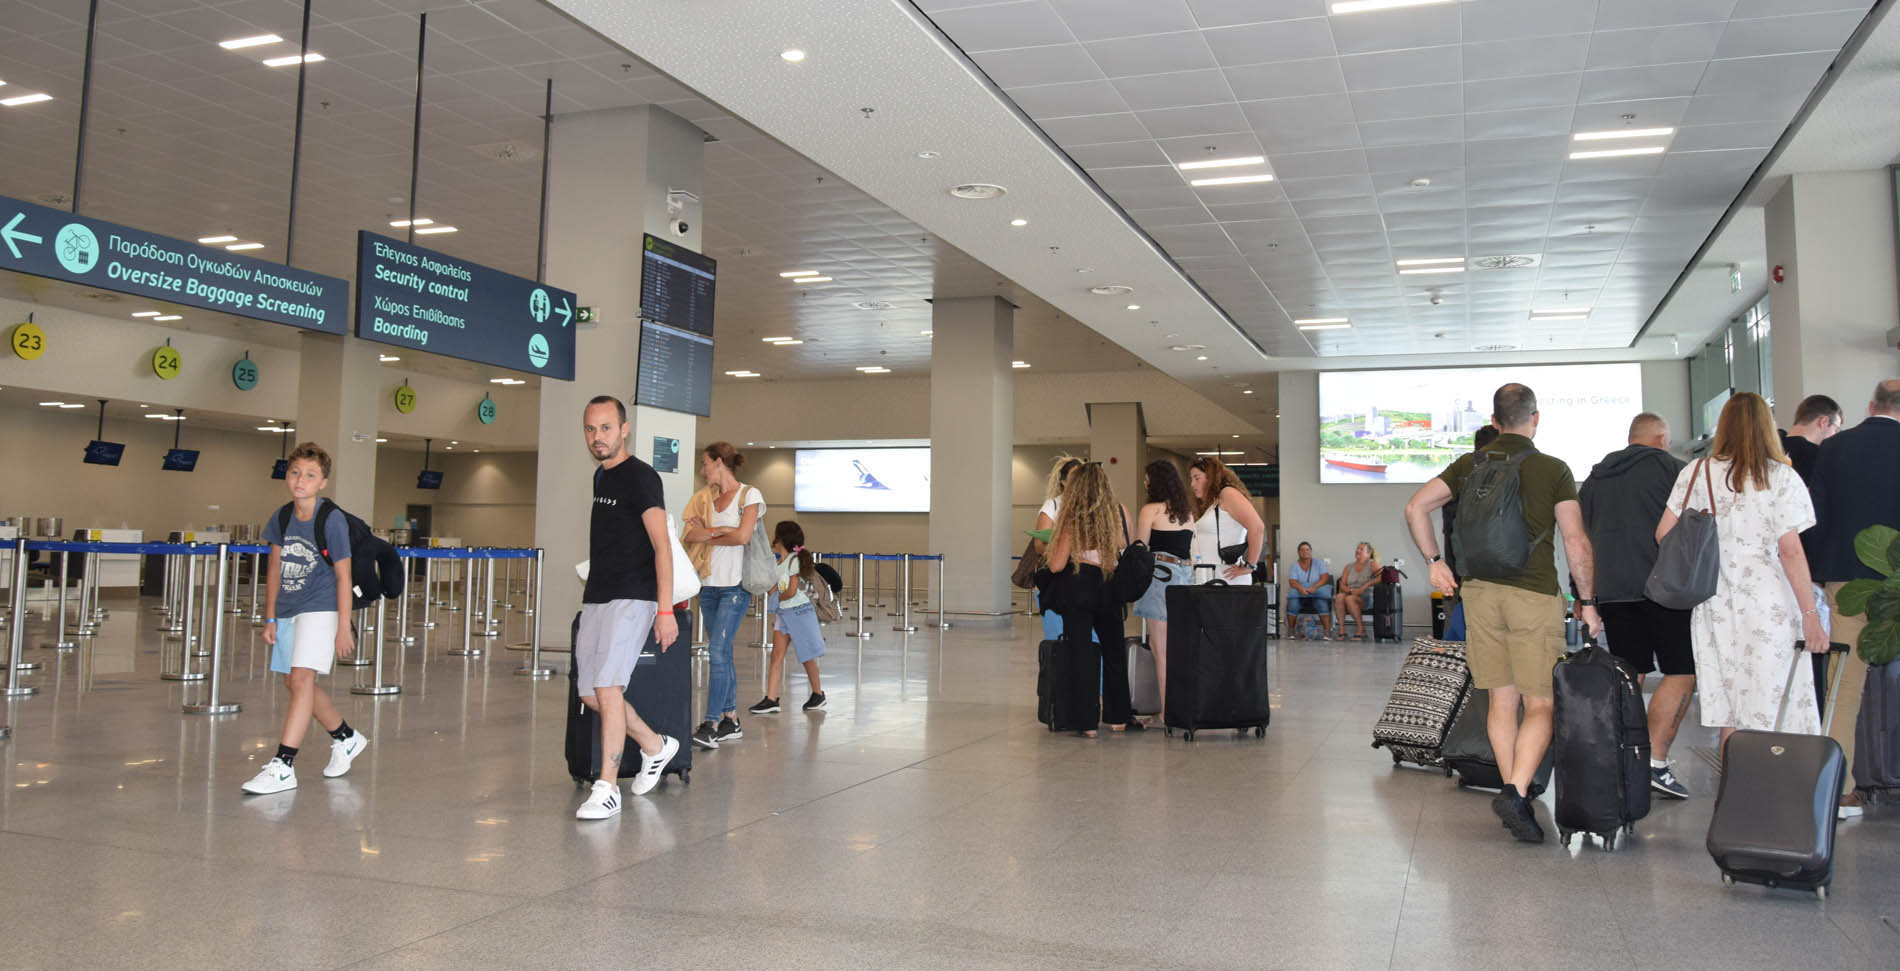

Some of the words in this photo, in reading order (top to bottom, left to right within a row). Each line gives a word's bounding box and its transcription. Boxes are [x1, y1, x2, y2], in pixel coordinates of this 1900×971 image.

[108, 234, 184, 267] Παράδοση
[187, 253, 252, 281] Ογκωδών
[253, 269, 324, 297] Αποσκευών
[373, 241, 418, 267] Έλεγχος
[420, 256, 472, 282] Ασφαλείας
[107, 261, 183, 292] Oversize
[185, 277, 254, 309] Baggage
[256, 293, 326, 325] Screening
[374, 264, 426, 294] Security
[428, 281, 469, 303] control
[374, 295, 410, 316] Χώρος
[412, 304, 466, 329] Επιβίβασης
[18, 332, 42, 350] 23
[373, 317, 429, 345] Boarding
[158, 355, 179, 371] 24
[237, 367, 256, 382] 25
[399, 393, 415, 408] 27
[482, 405, 495, 418] 28
